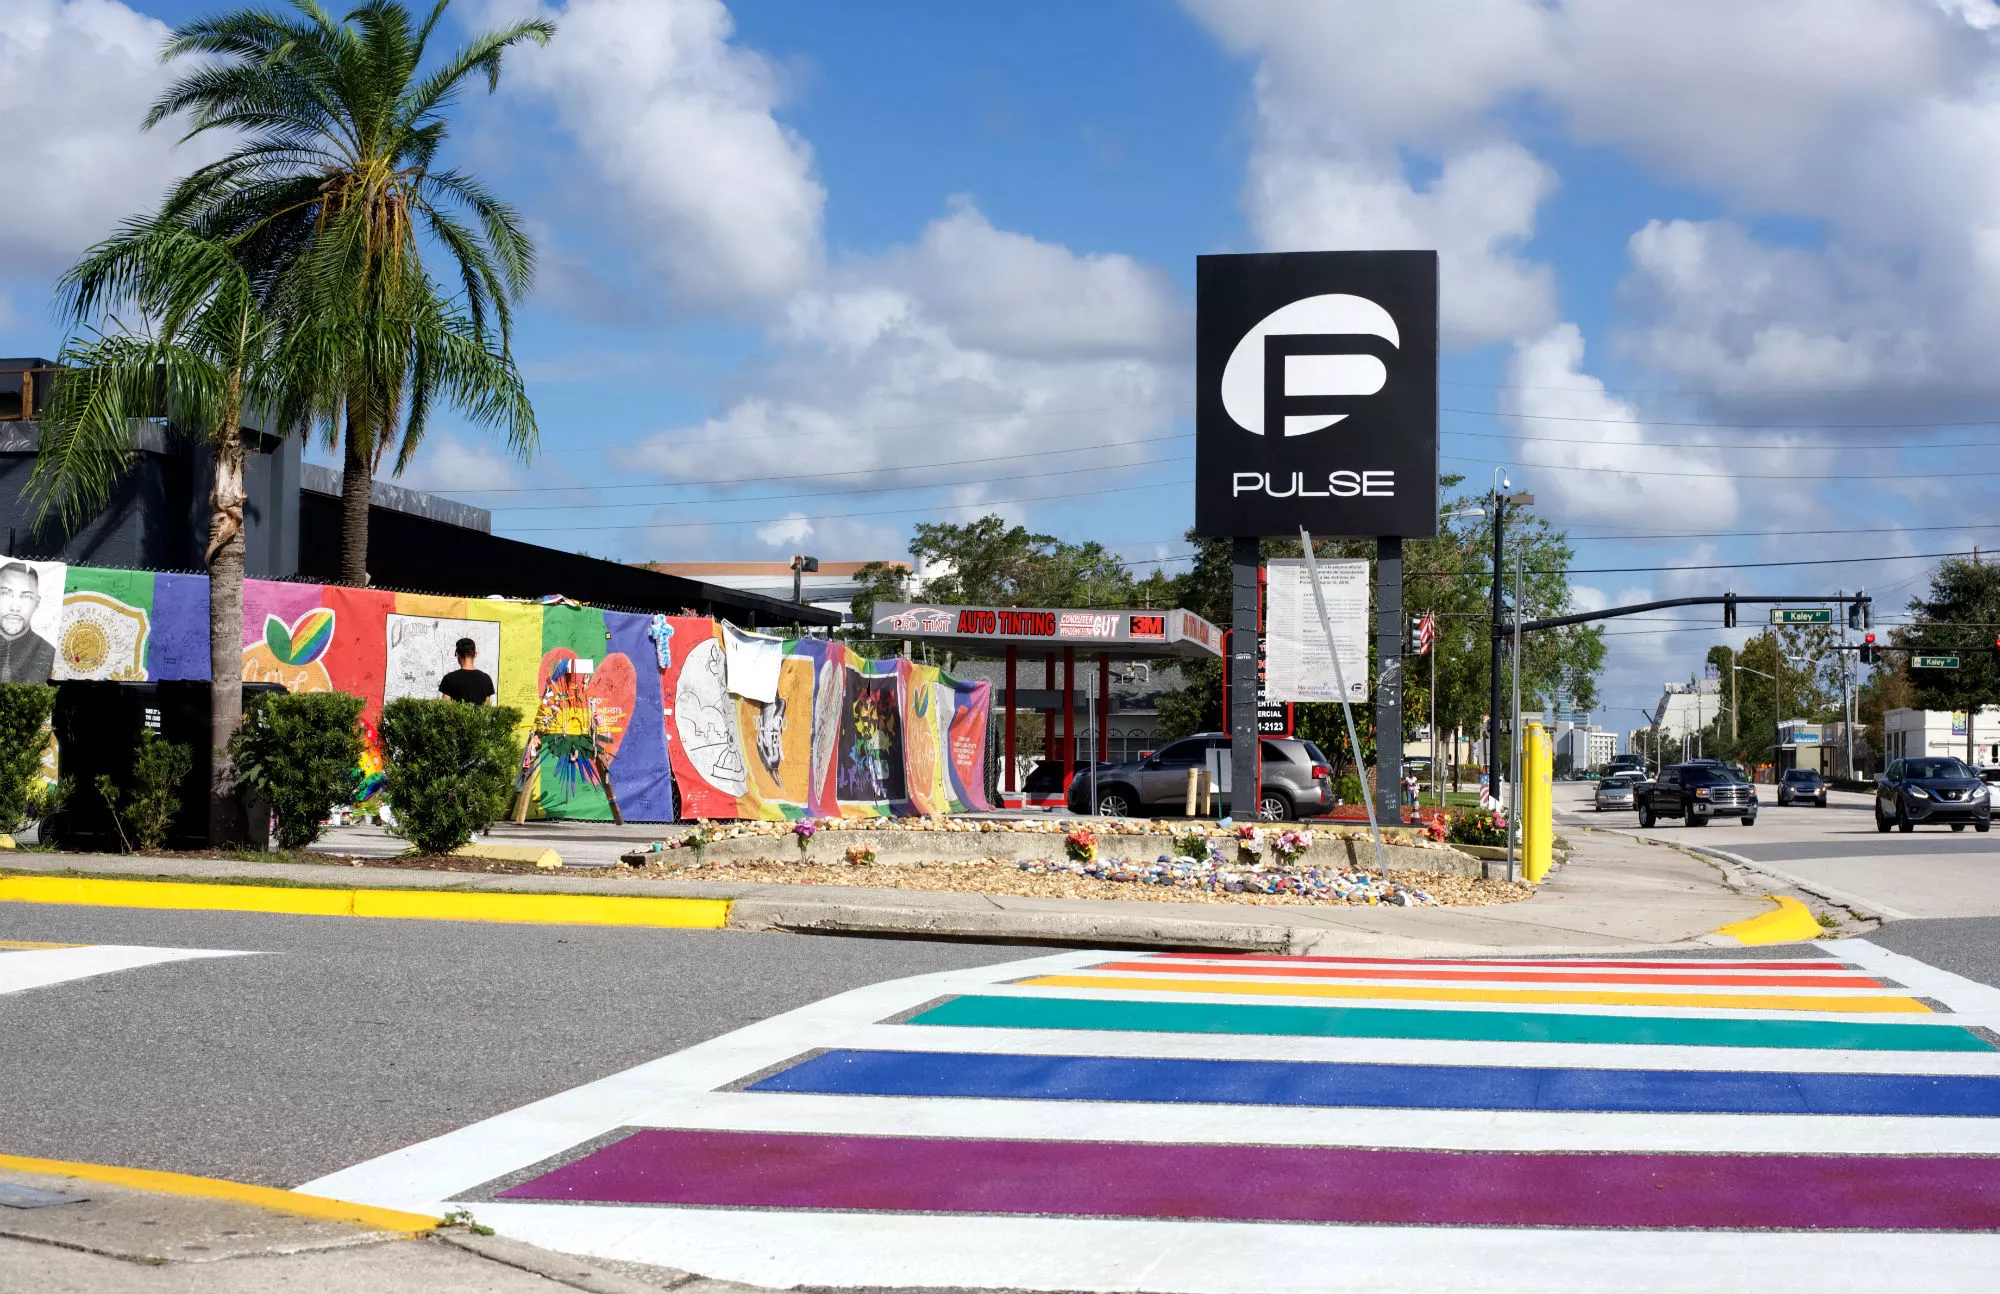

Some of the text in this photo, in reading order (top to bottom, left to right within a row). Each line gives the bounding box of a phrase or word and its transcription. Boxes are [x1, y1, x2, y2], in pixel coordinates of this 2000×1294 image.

[1233, 470, 1395, 497] PULSE
[1791, 611, 1813, 622] Kaley
[893, 619, 951, 633] PRO TINT
[957, 610, 1056, 636] AUTO TINTING
[1093, 615, 1120, 638] CUT
[1132, 617, 1162, 634] 3M
[1926, 658, 1945, 667] Kaley
[1257, 700, 1282, 708] ENTIAL
[1257, 710, 1282, 718] ERCIAL
[1257, 722, 1284, 731] 1-2123
